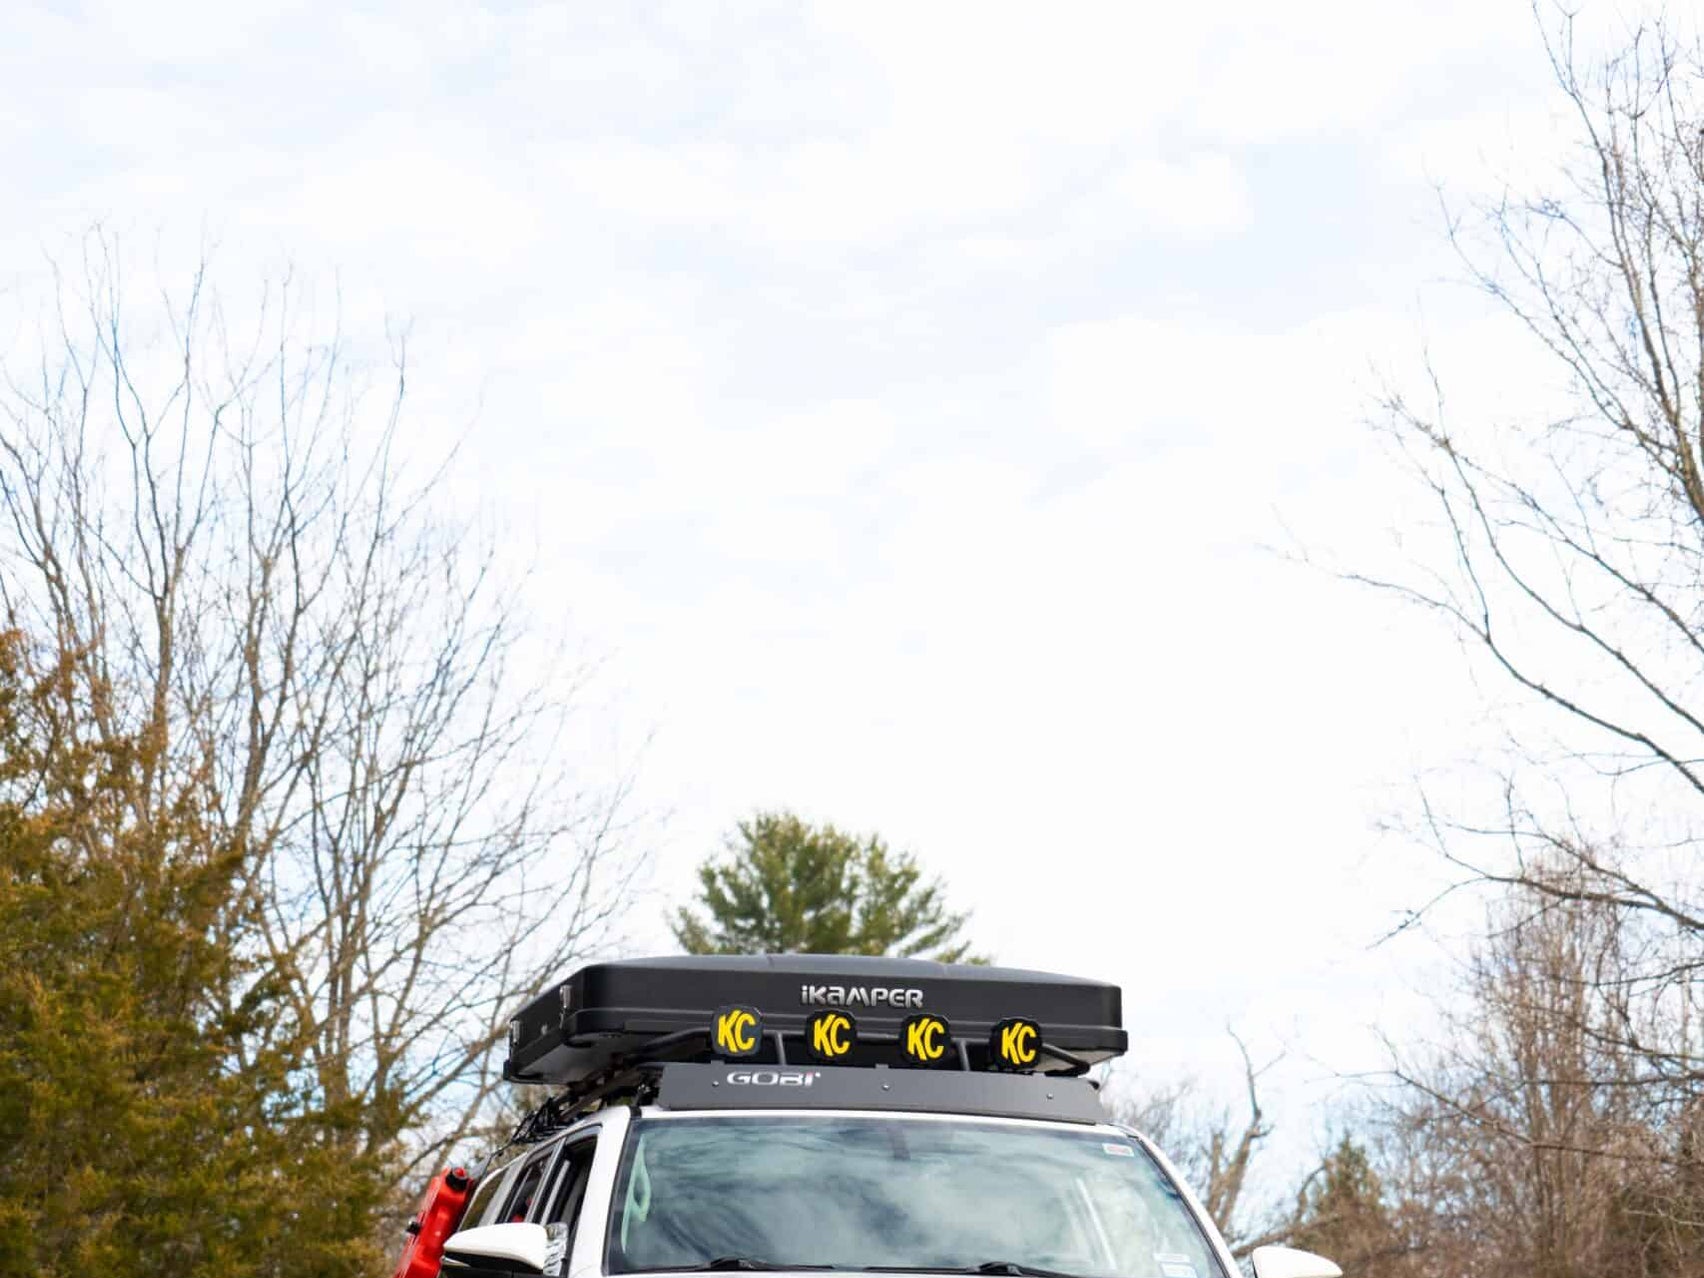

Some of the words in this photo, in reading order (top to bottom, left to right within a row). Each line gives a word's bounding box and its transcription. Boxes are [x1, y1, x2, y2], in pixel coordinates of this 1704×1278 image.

[717, 1009, 756, 1053] KC
[813, 1013, 851, 1057] KC
[908, 1017, 946, 1061] KC
[1001, 1022, 1037, 1065] KC
[726, 1071, 815, 1087] GOBI
